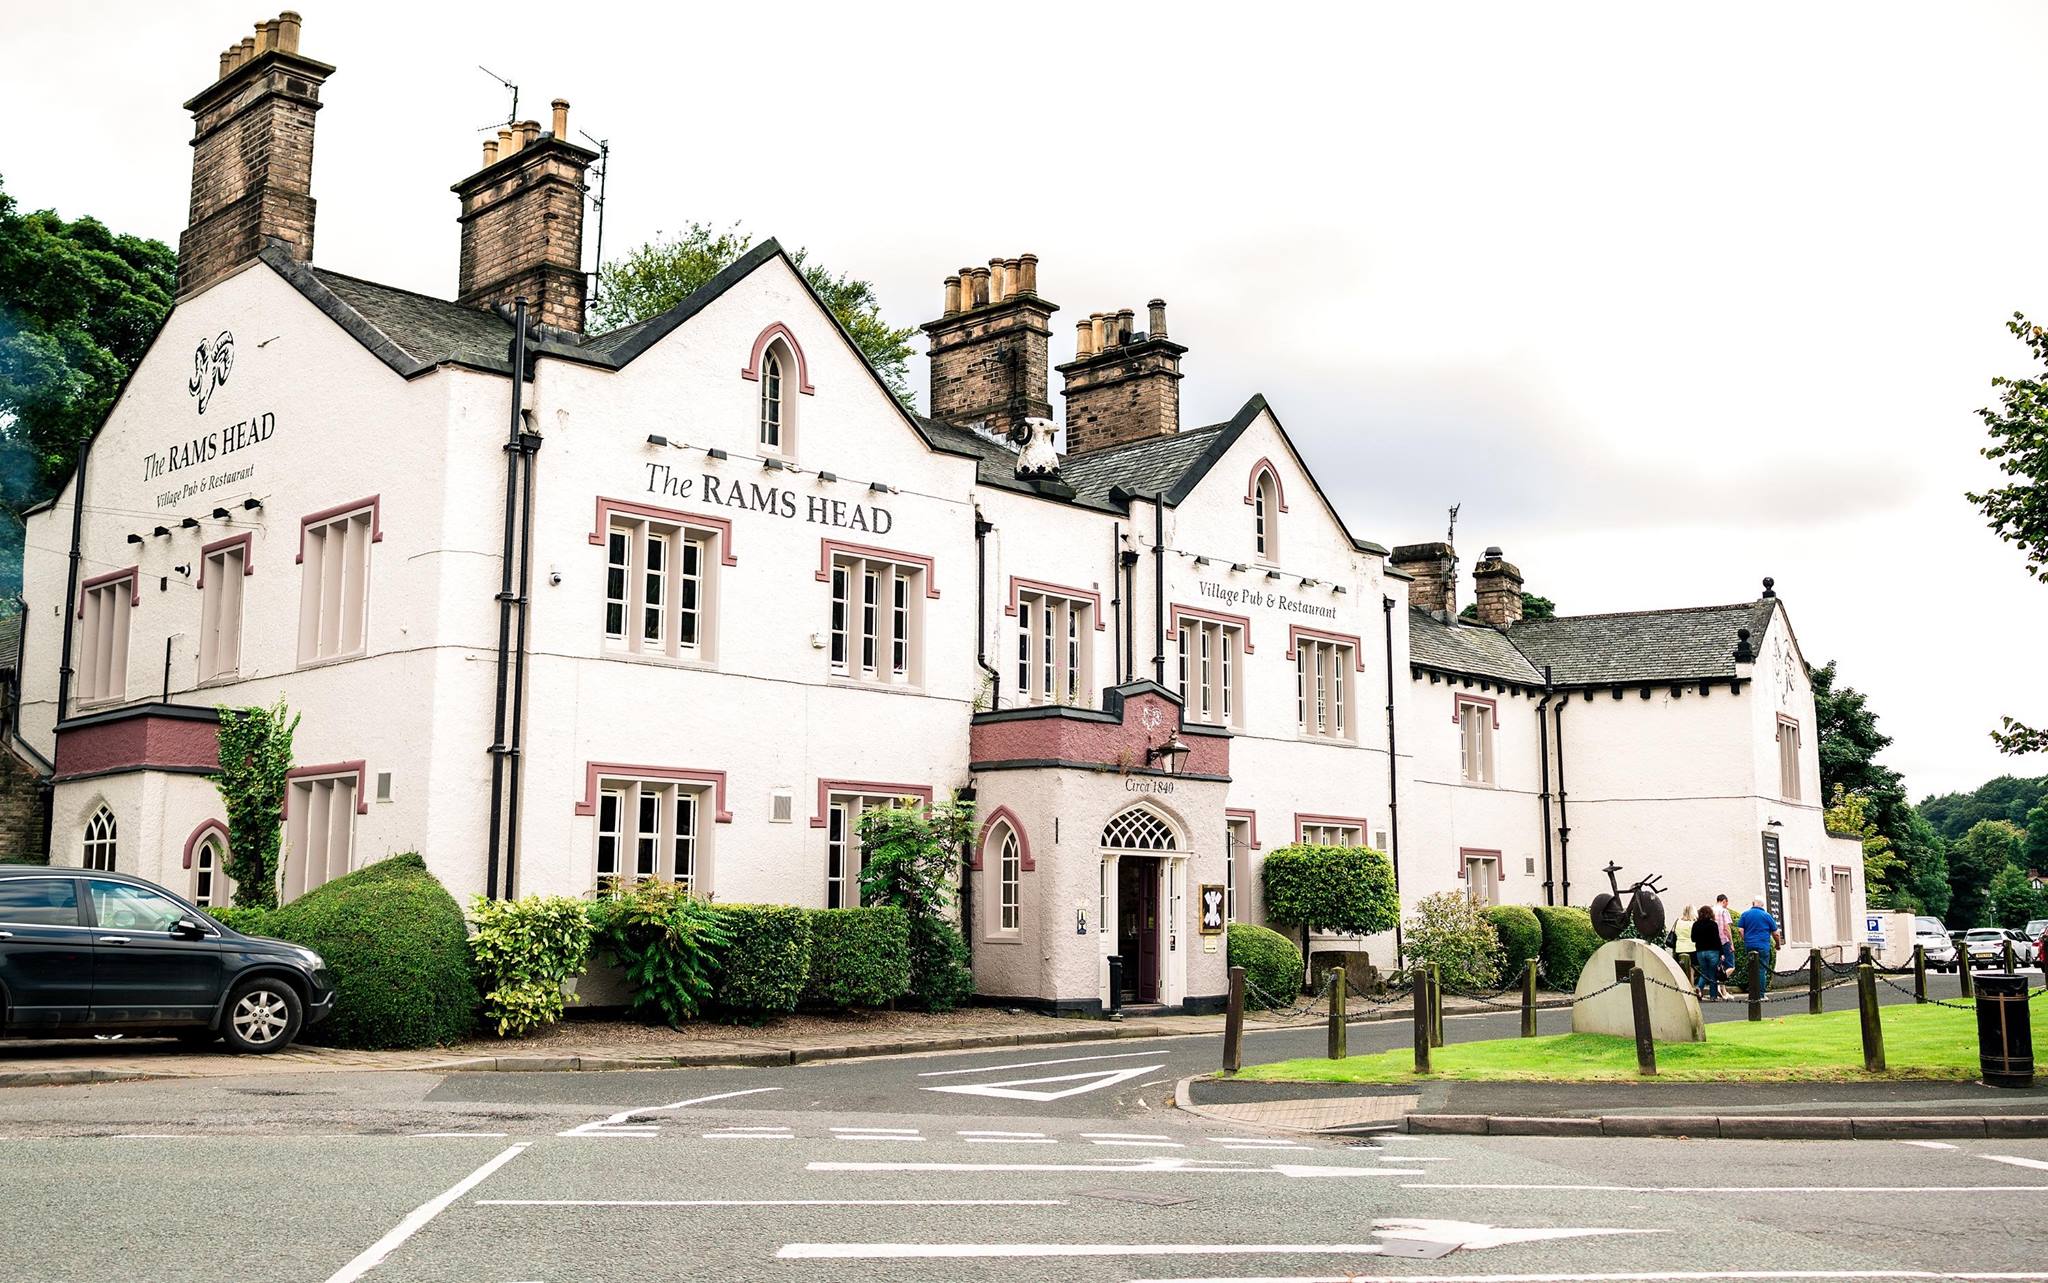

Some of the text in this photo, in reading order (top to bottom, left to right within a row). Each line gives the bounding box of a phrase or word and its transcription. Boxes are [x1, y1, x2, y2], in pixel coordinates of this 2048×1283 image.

[143, 411, 276, 482] The RAMS HEAD
[156, 464, 255, 509] Village Pub & Restaurant
[645, 461, 893, 536] The RAMS HEAD
[1199, 580, 1337, 620] Village Pub & Restaurant
[1125, 778, 1174, 794] Circa 1840
[1868, 920, 1877, 930] P
